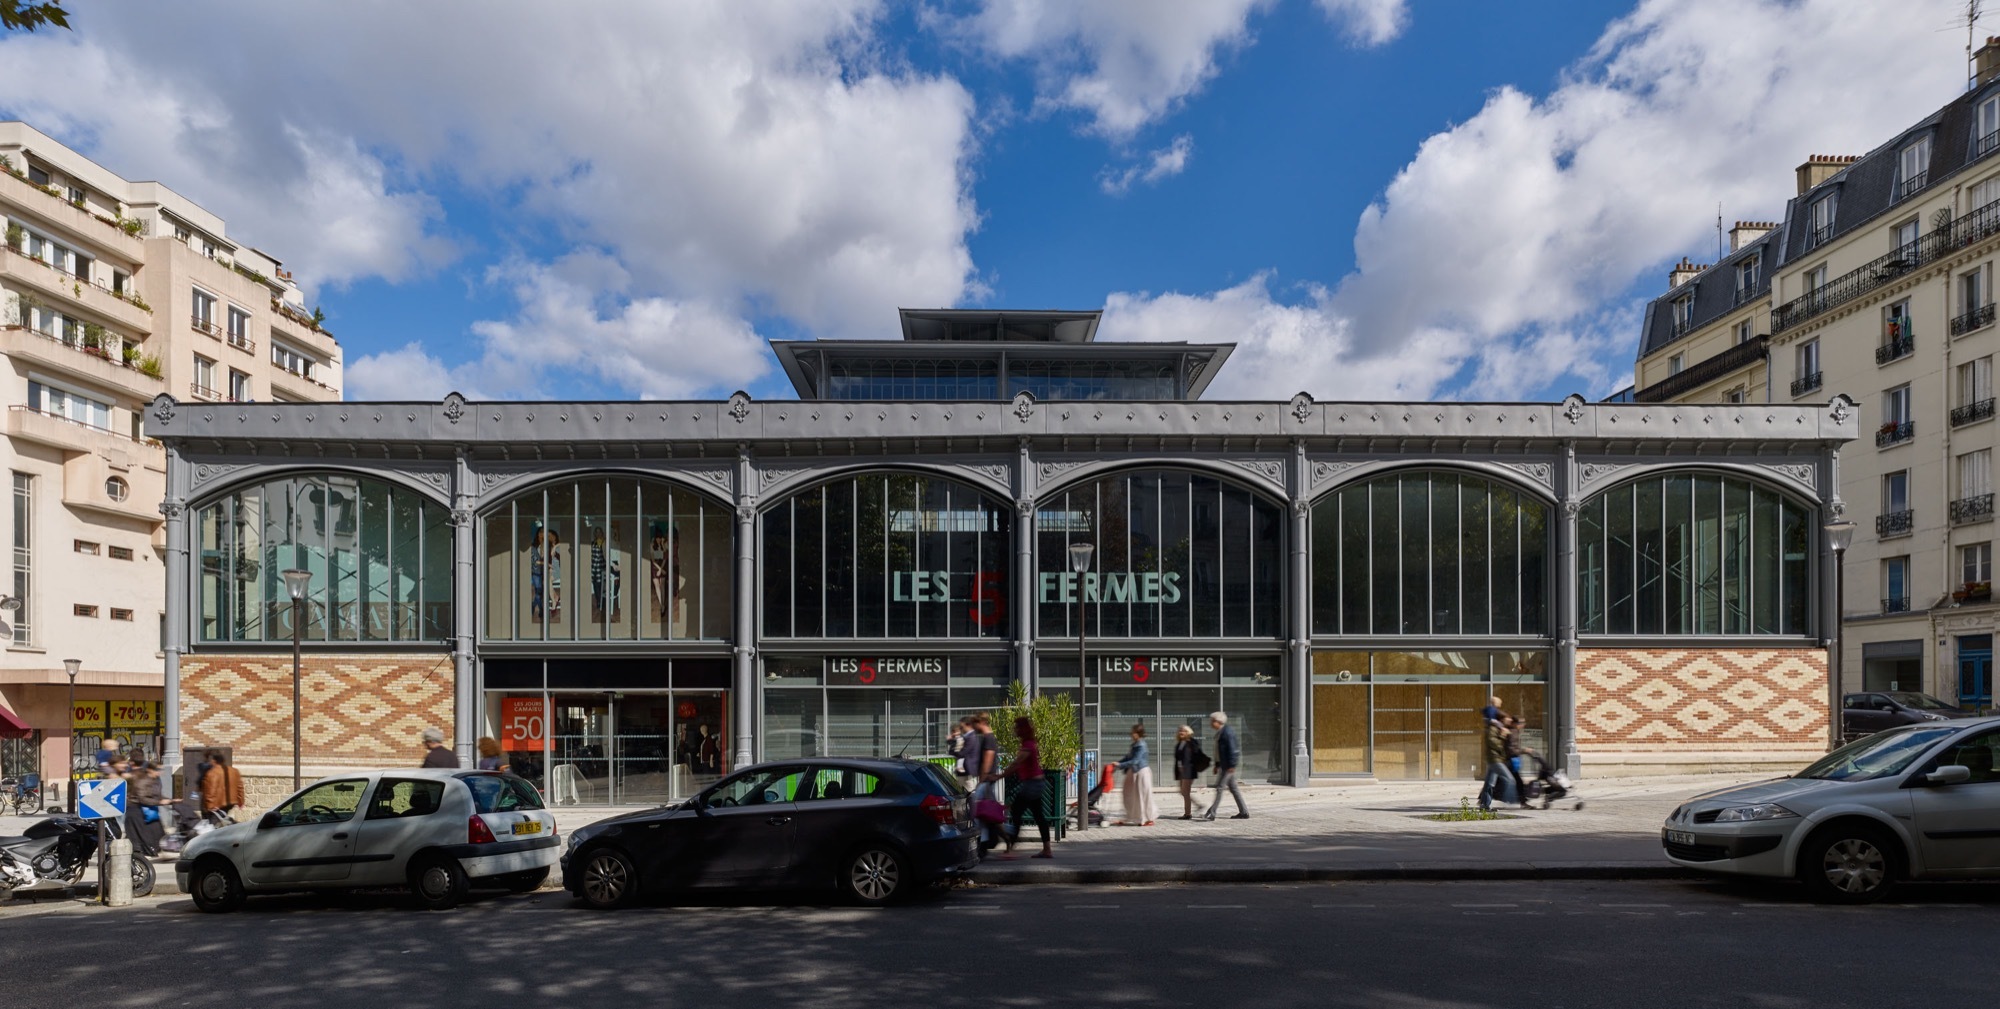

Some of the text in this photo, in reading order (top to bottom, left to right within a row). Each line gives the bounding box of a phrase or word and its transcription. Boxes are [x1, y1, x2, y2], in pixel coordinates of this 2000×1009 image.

[893, 570, 1181, 626] LES 5 FERMES
[282, 604, 451, 632] CAMAEU
[832, 657, 942, 683] LES 5 FERMES
[1106, 657, 1214, 682] LES 5 FERMES
[73, 707, 100, 721] 0%
[113, 707, 149, 720] -70%
[505, 716, 545, 740] -50
